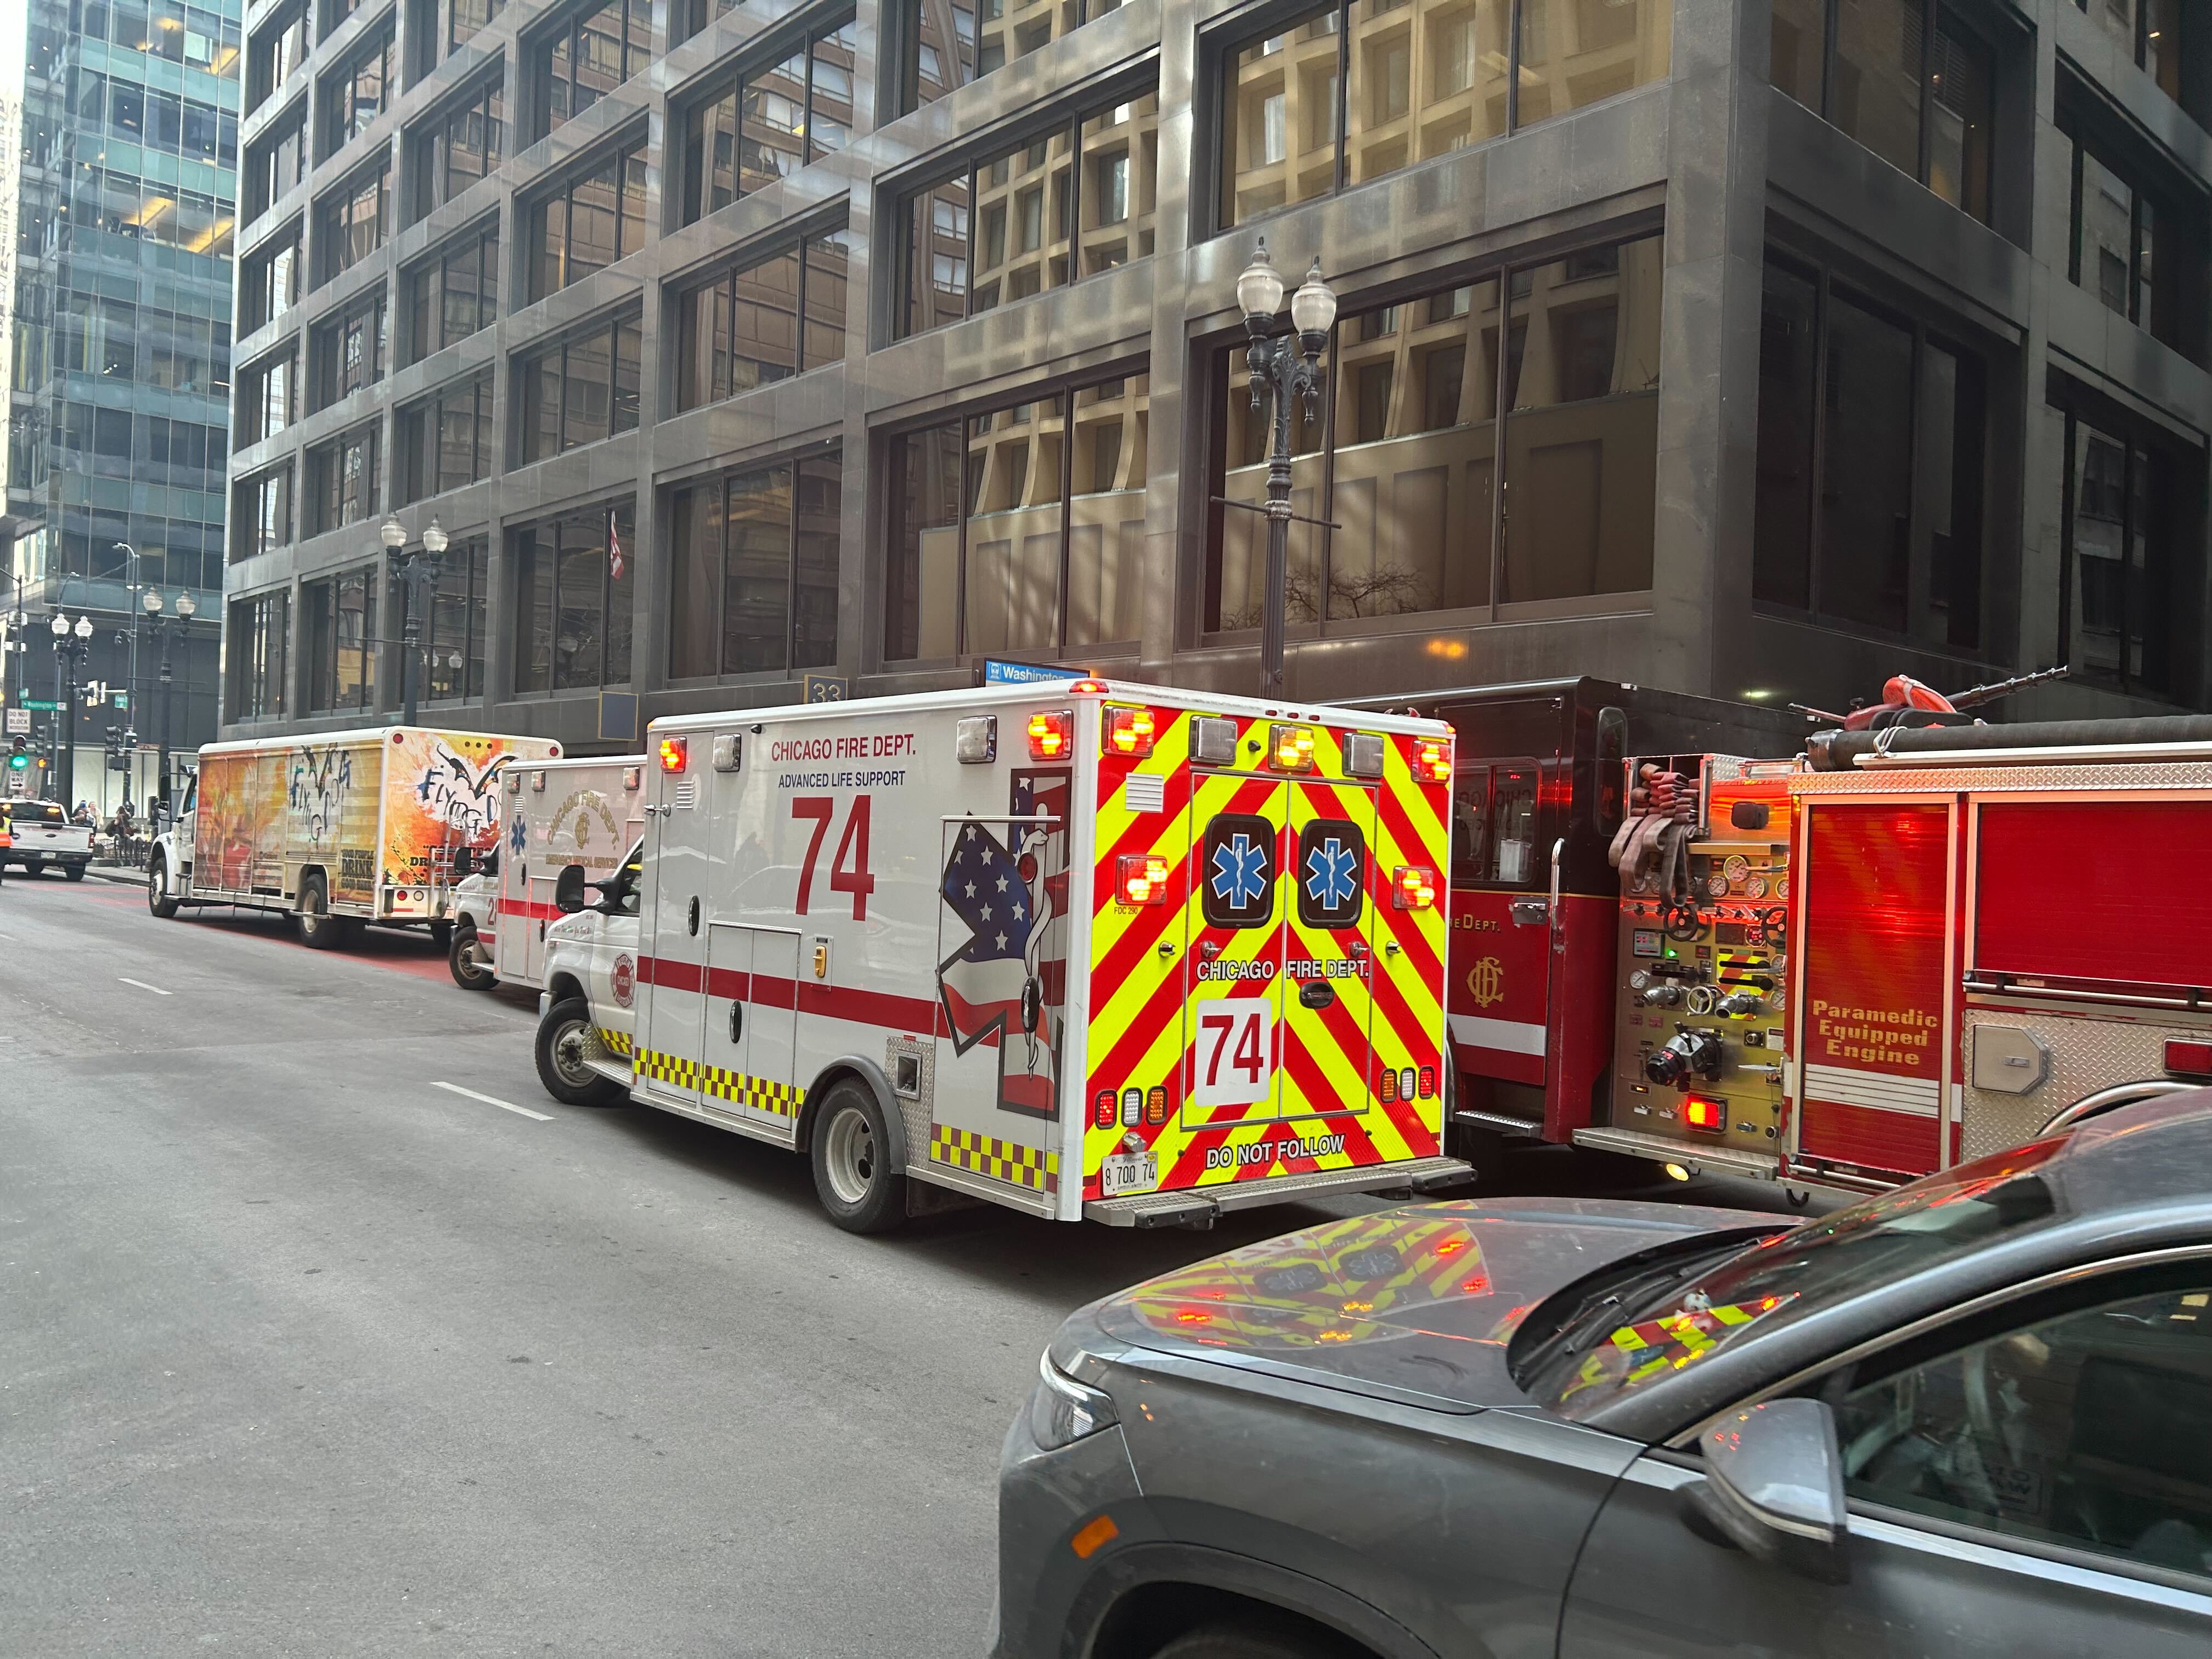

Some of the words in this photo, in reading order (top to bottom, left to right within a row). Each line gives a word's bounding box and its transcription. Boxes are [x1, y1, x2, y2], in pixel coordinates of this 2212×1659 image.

[812, 683, 840, 702] 33
[771, 738, 832, 761] CHICAGO
[837, 736, 868, 759] FIRE
[873, 733, 916, 757] DEPT.
[778, 774, 829, 788] ADVANCED
[832, 772, 853, 787] LIFE
[855, 770, 906, 787] SUPPORT
[548, 791, 579, 845] CHICAGO
[582, 789, 601, 812] FIRE
[341, 859, 374, 876] DRINK
[792, 795, 874, 921] 74
[487, 897, 496, 926] 2
[1114, 906, 1126, 915] FDC
[1128, 906, 1138, 915] 290
[1463, 913, 1501, 932] DEPT.
[619, 956, 629, 964] FIRE
[1197, 960, 1275, 981] CHICAGO
[1286, 960, 1323, 978] FIRE
[1327, 960, 1369, 978] DEPT.
[1813, 1000, 1938, 1028] Paramedic
[1819, 1019, 1928, 1046] Equipped
[1202, 1013, 1263, 1086] 74
[1826, 1039, 1920, 1065] Engine
[1206, 1146, 1233, 1169] DO
[1237, 1142, 1273, 1166] NOT
[1277, 1133, 1346, 1160] FOLLOW
[1105, 1167, 1111, 1186] 8
[1117, 1165, 1136, 1185] 700
[1143, 1163, 1155, 1182] 74
